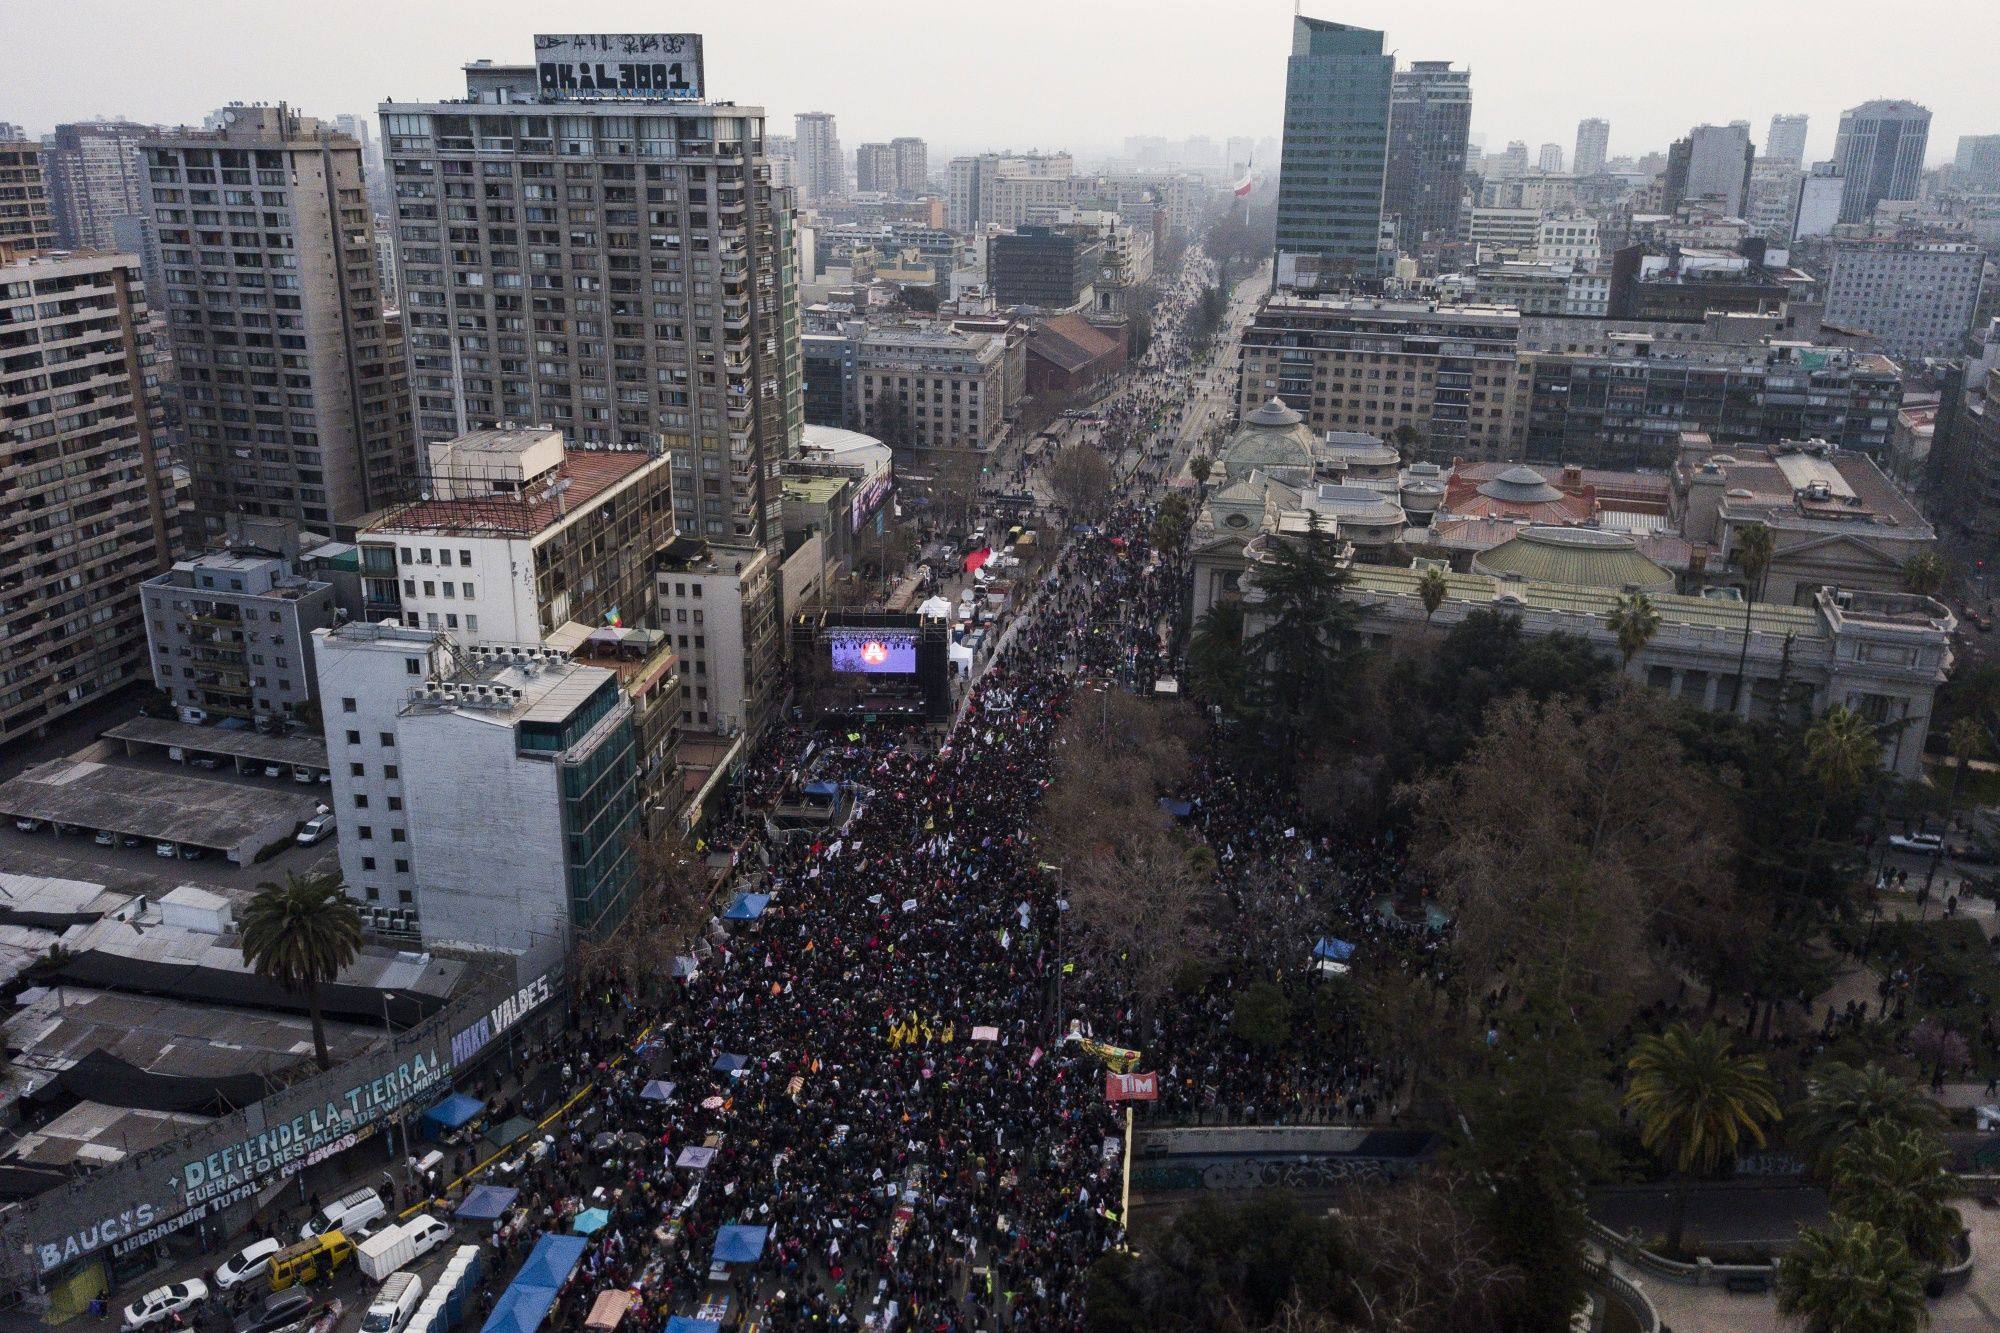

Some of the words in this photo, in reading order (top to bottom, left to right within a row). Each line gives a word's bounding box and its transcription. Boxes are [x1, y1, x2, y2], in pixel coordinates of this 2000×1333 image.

[309, 1102, 342, 1133] LA
[185, 1173, 240, 1207] FUERA
[243, 1119, 352, 1181] FORESTALES
[357, 1106, 377, 1126] DE
[211, 1181, 262, 1212] TOTAL
